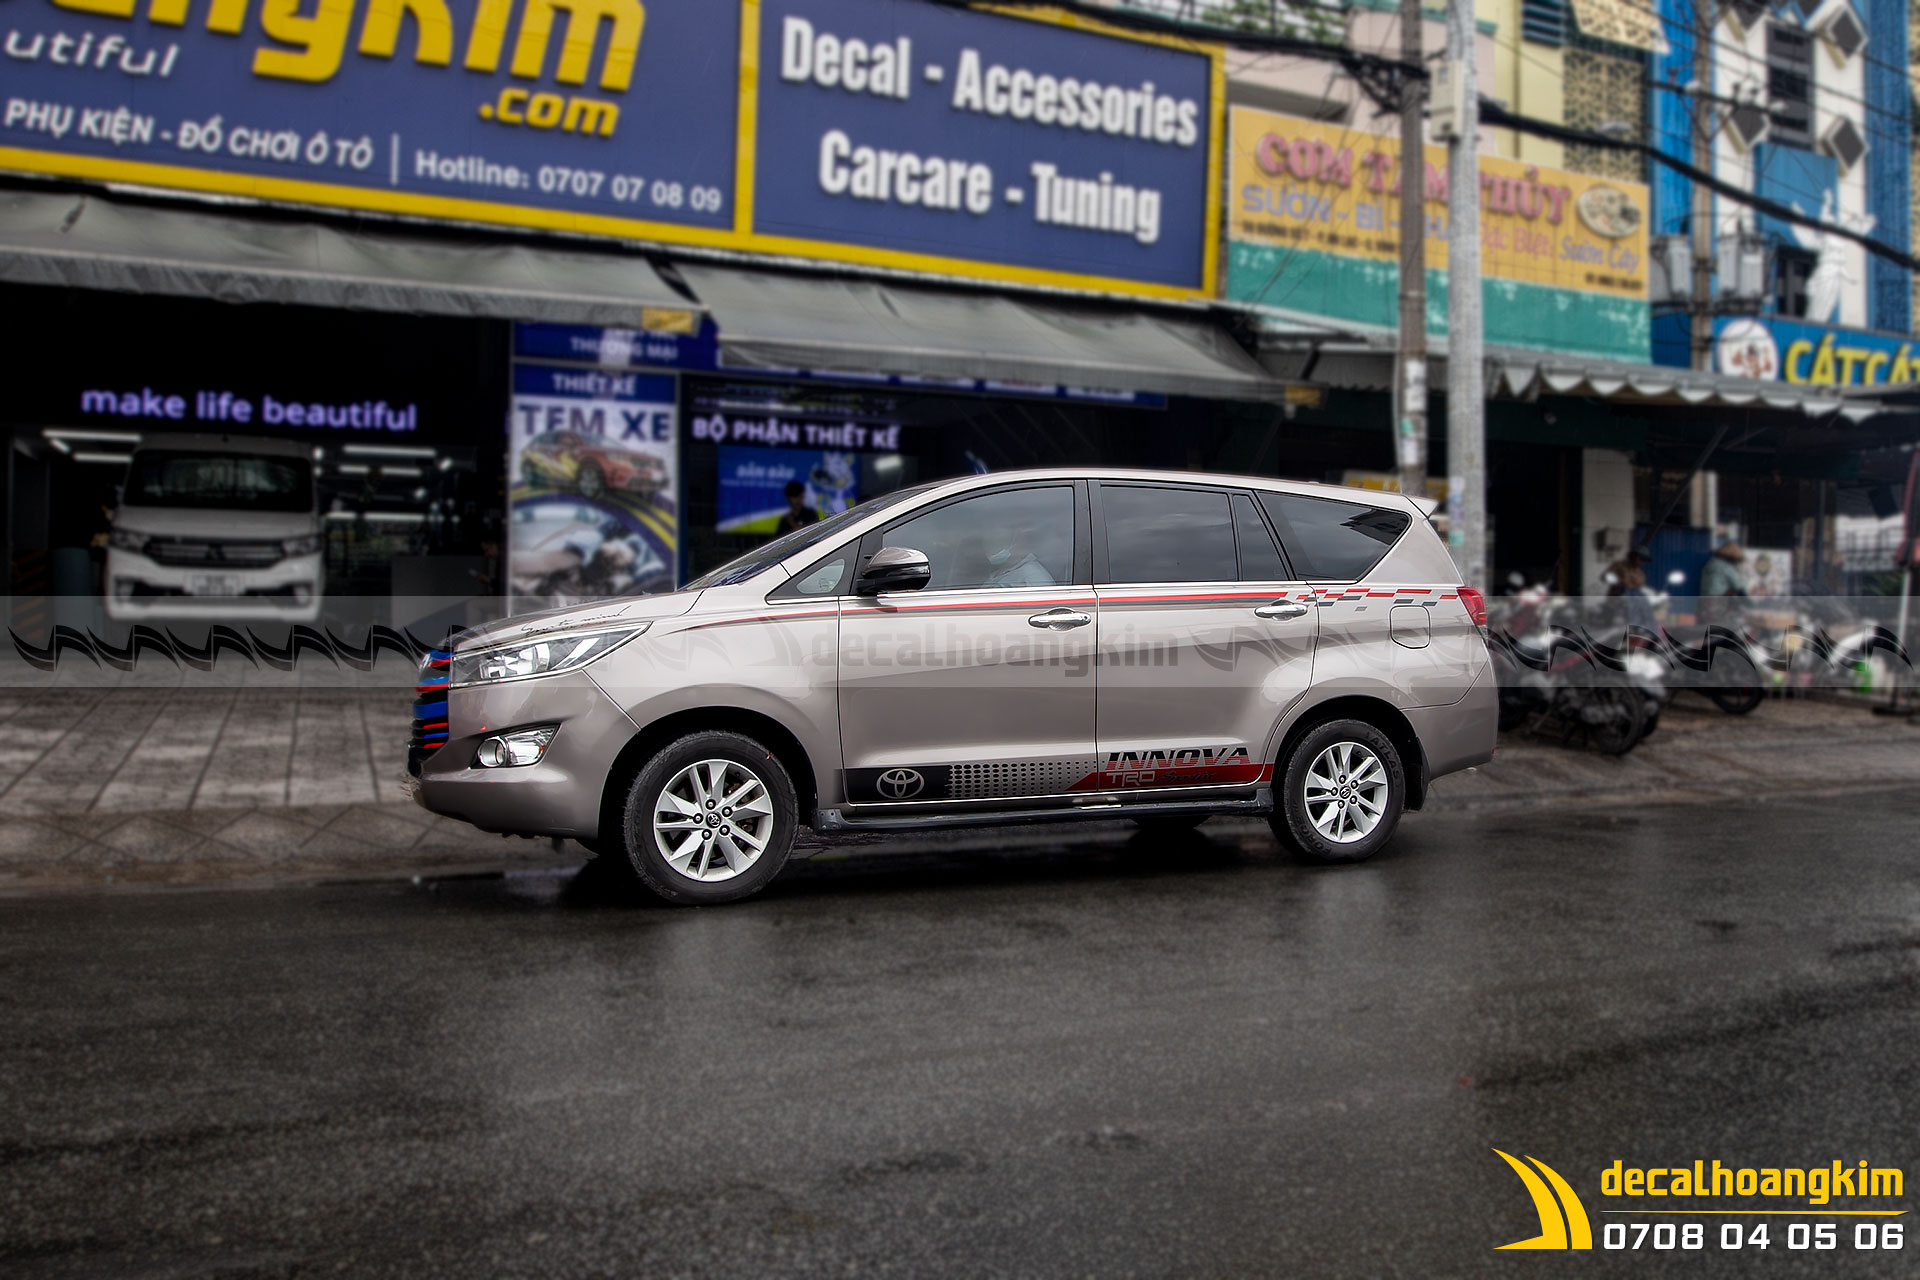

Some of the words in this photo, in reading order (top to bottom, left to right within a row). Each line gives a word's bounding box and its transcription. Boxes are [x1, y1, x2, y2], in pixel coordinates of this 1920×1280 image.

[4, 30, 180, 77] utiful
[781, 15, 910, 98] Decal
[953, 48, 1198, 146] Accessories
[4, 98, 74, 138] PHỤ
[79, 106, 155, 145] KIỆN
[306, 131, 329, 165] Ô
[335, 136, 374, 169] TÔ
[480, 87, 620, 137] .com
[415, 150, 529, 189] Hotline:
[538, 166, 604, 196] 0707
[612, 174, 643, 200] 07
[651, 179, 683, 207] 08
[690, 184, 722, 211] 09
[818, 129, 992, 213] Carcare
[1031, 162, 1161, 245] Tuning
[81, 387, 186, 419] make
[196, 391, 252, 422] life
[262, 395, 417, 431] beautiful
[620, 409, 671, 442] XE
[692, 414, 727, 442] BỘ
[805, 424, 868, 448] THIẾT
[1105, 746, 1251, 771] INNOVA
[1106, 771, 1155, 787] TRD
